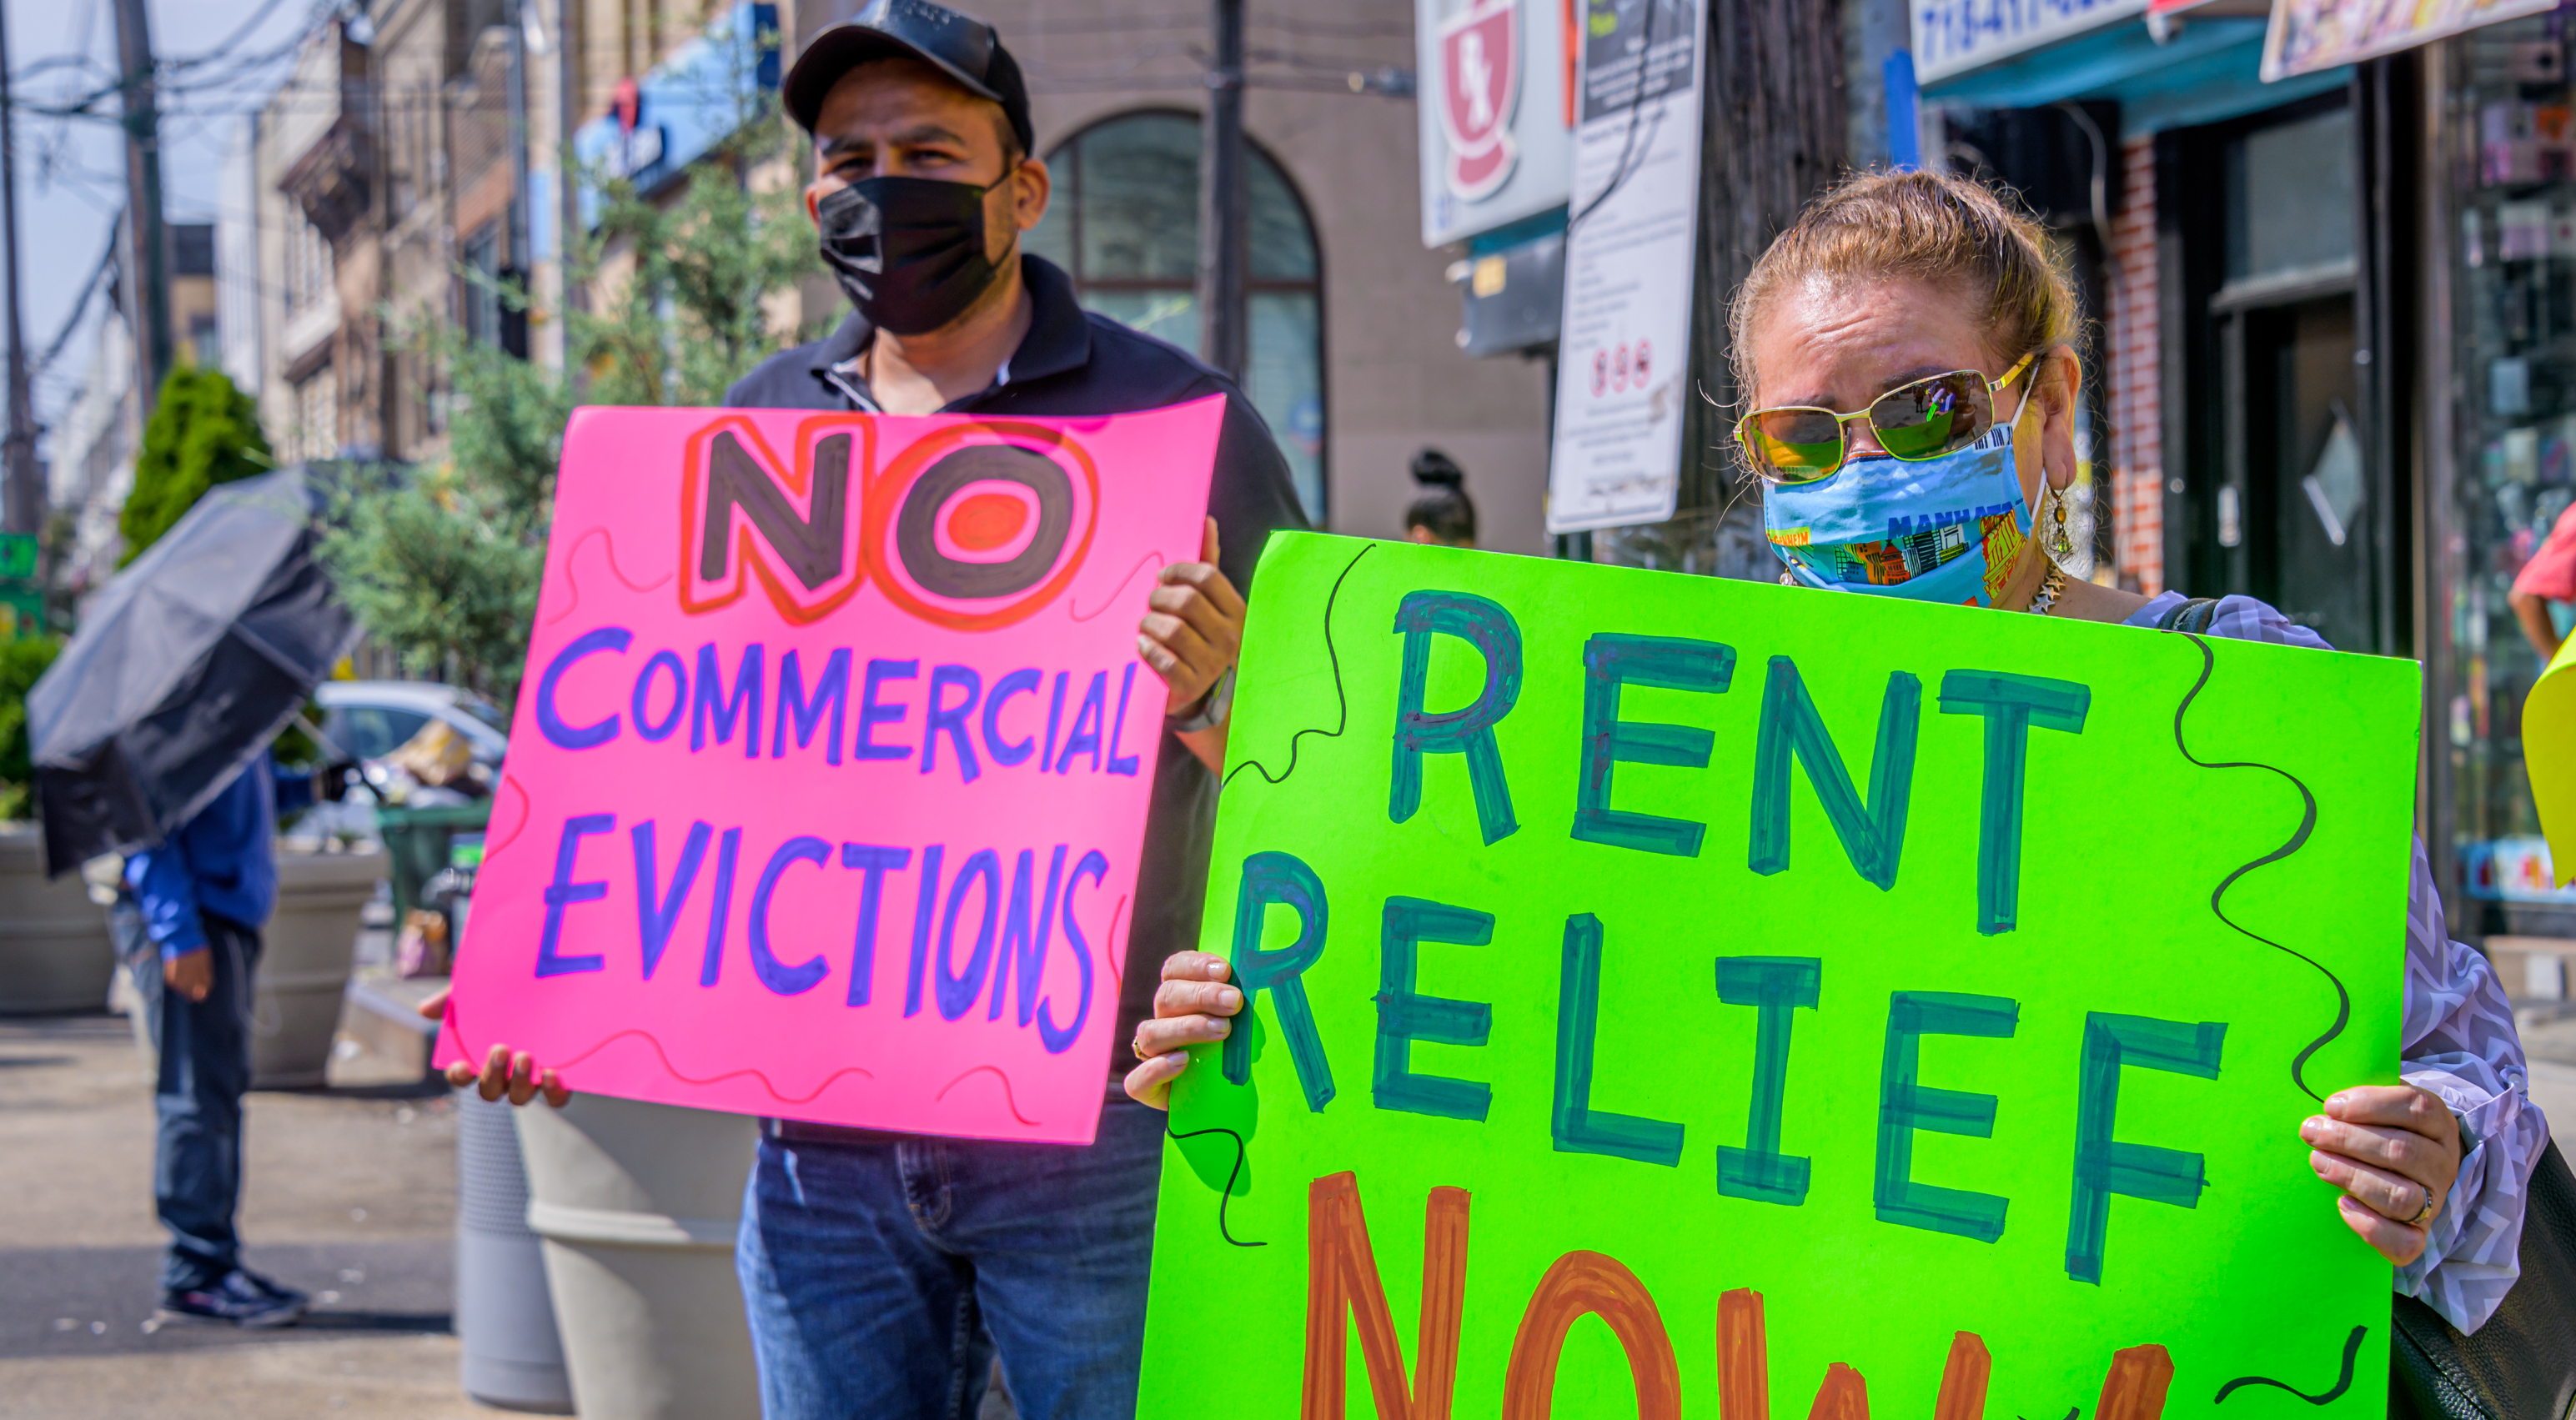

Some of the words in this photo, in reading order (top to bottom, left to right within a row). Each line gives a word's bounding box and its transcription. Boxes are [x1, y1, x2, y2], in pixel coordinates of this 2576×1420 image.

[680, 415, 1099, 632] NO
[535, 626, 1141, 784] COMMERCIAL
[1388, 589, 2091, 937] RENT
[535, 813, 1110, 1055] EVICTIONS
[1221, 850, 2229, 1286] RELIEF
[1301, 1171, 2175, 1420] NO
